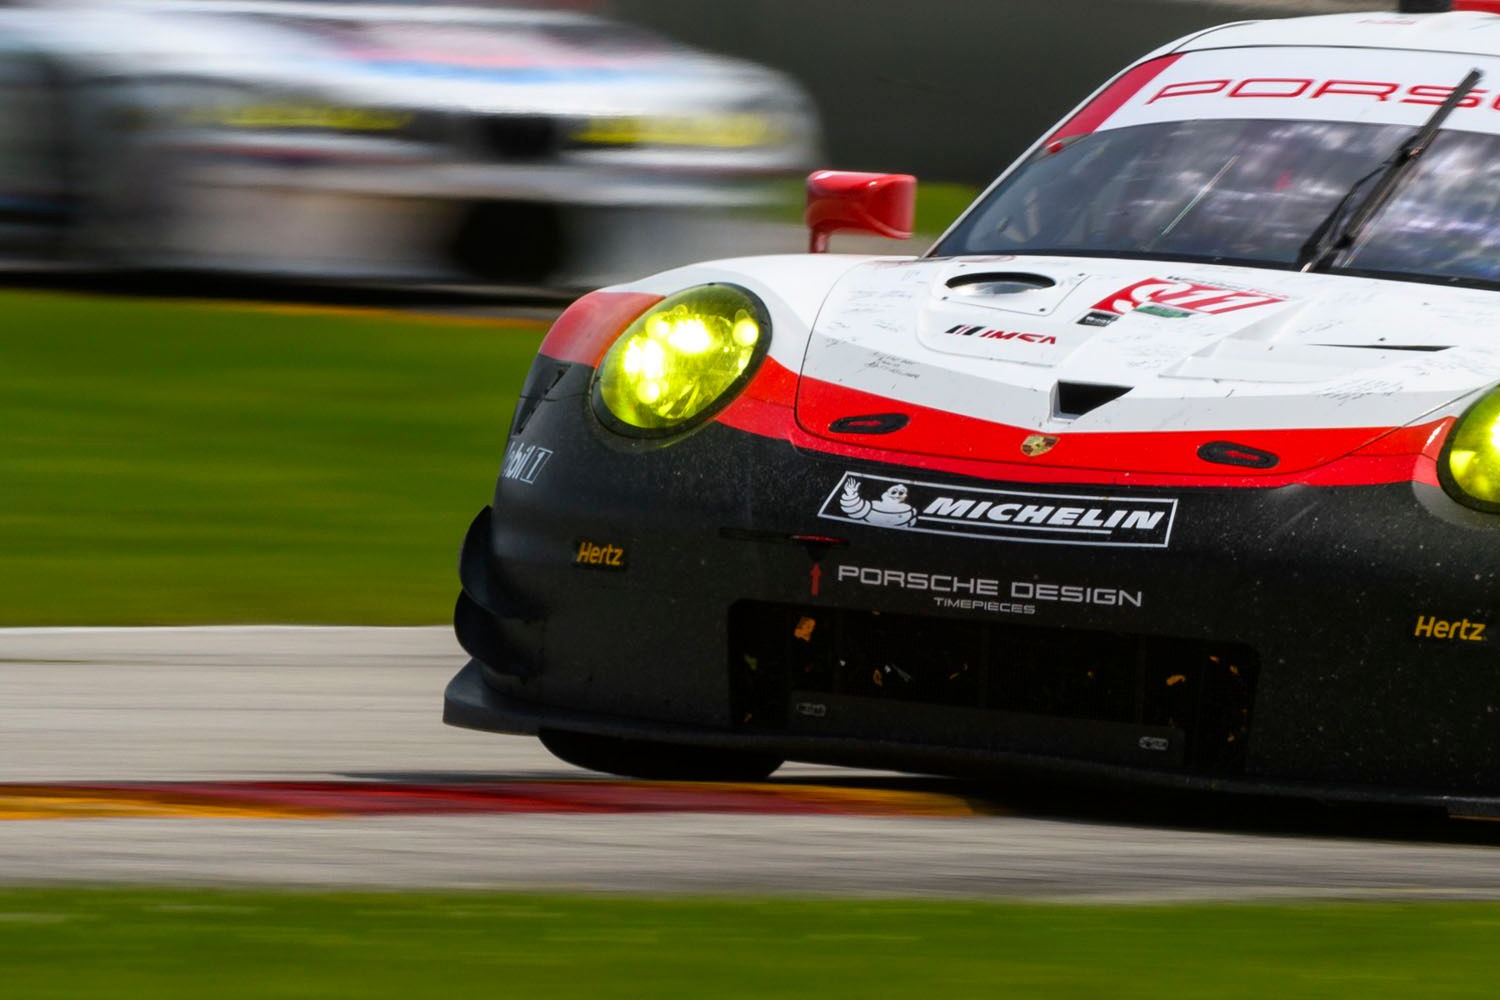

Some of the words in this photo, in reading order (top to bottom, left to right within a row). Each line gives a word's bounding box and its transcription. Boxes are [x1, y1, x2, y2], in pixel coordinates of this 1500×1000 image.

[979, 329, 1057, 345] IMSA
[922, 496, 1166, 530] MICHELIN
[576, 542, 624, 566] Hertz
[837, 564, 999, 596] PORSCHE
[1010, 581, 1142, 608] DESIGN
[933, 596, 1036, 615] TIMEPIECES
[1414, 615, 1486, 641] Hertz
